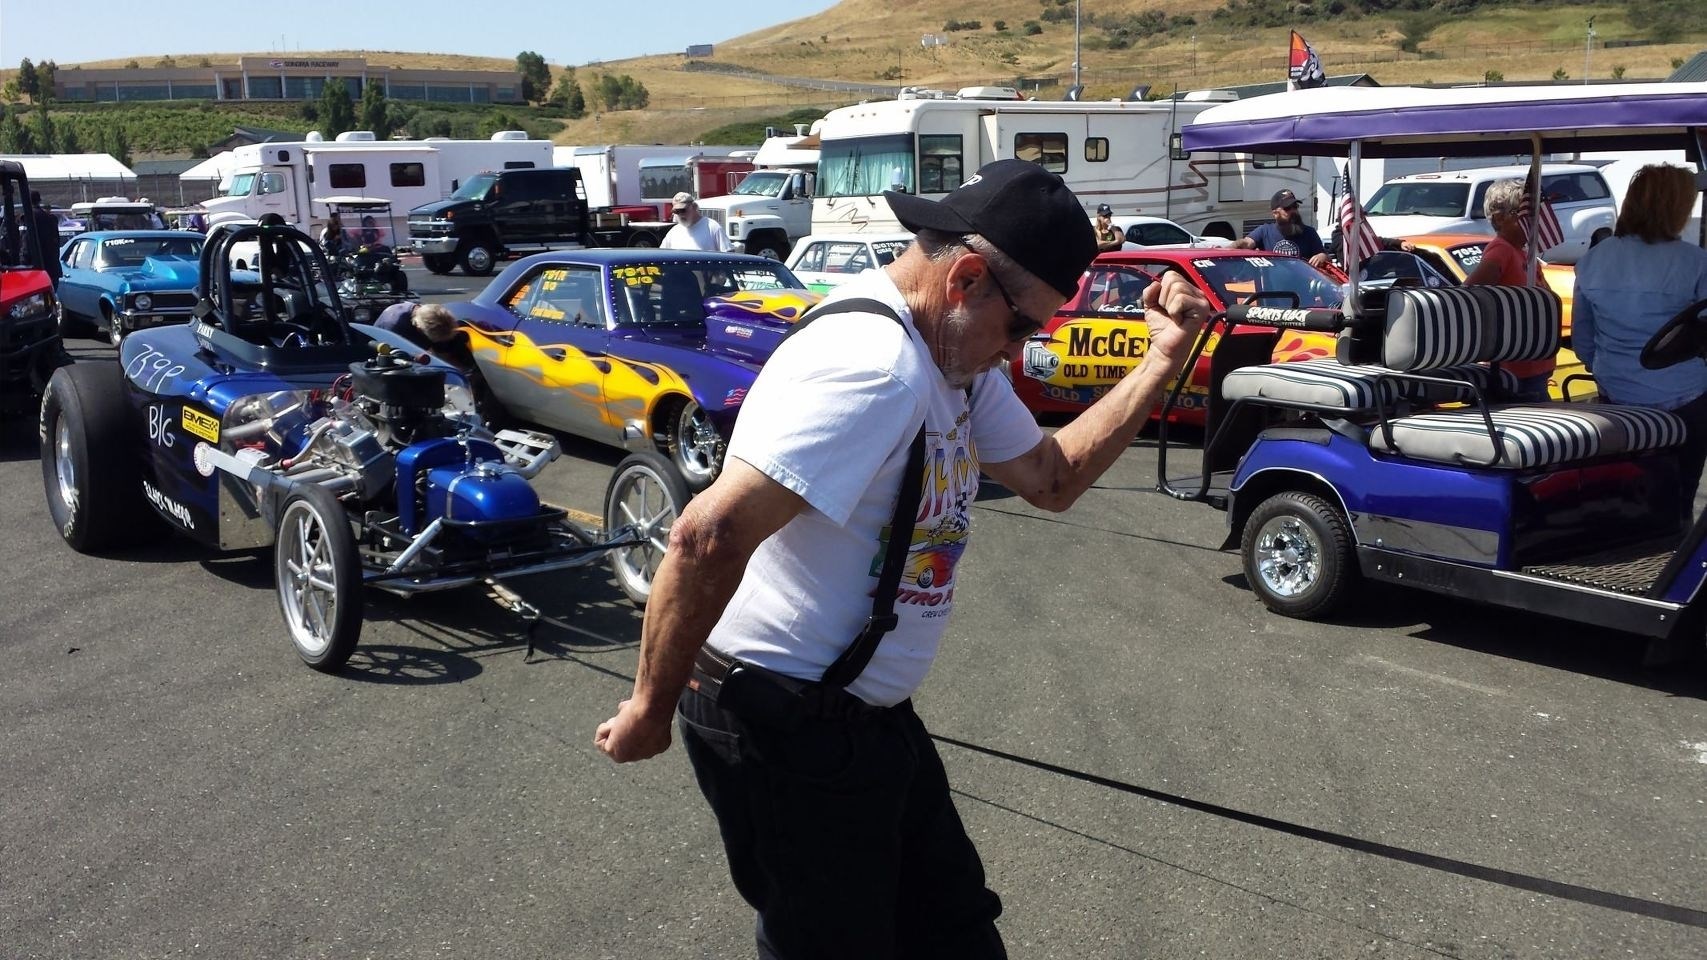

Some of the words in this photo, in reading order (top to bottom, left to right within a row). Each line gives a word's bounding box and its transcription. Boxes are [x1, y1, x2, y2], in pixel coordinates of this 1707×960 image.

[1245, 306, 1285, 321] SPORTS
[1281, 309, 1312, 323] RACK
[1063, 364, 1089, 378] OLD
[1094, 364, 1127, 379] TIME
[1050, 386, 1080, 400] OLD
